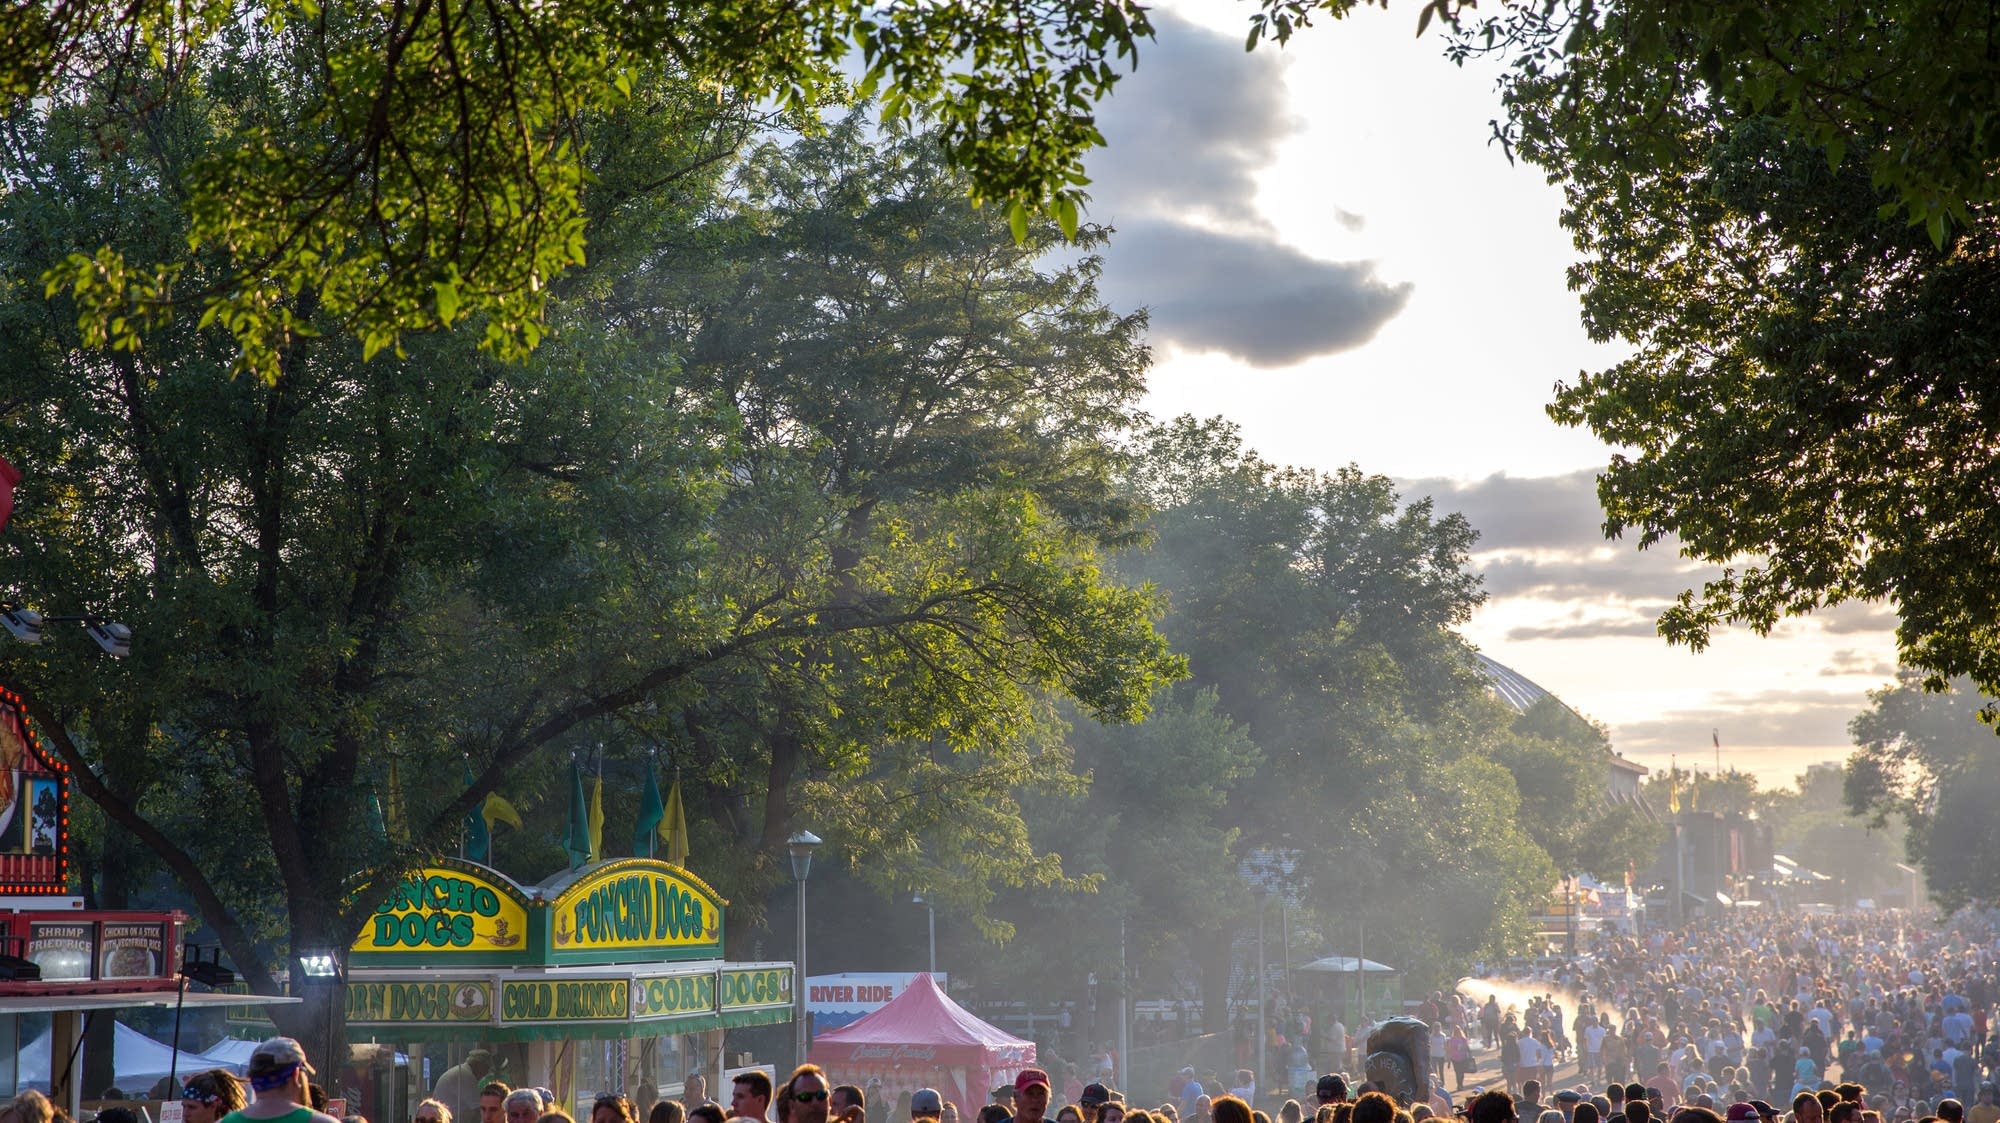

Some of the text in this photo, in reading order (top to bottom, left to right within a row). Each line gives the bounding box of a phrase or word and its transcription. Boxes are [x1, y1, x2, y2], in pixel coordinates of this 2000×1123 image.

[575, 874, 703, 943] PONCHO DOGS
[38, 927, 84, 938] SHRIMP
[104, 927, 129, 937] CHICKEN
[144, 927, 160, 938] STICK
[372, 912, 474, 947] DOGS
[29, 938, 93, 952] FRIED RICE
[149, 939, 162, 952] RICE
[390, 983, 449, 1019] DOGS
[504, 982, 626, 1018] COLD DRINKS
[648, 972, 778, 1012] CORN DOGS
[810, 985, 893, 1002] RIVER RIDE
